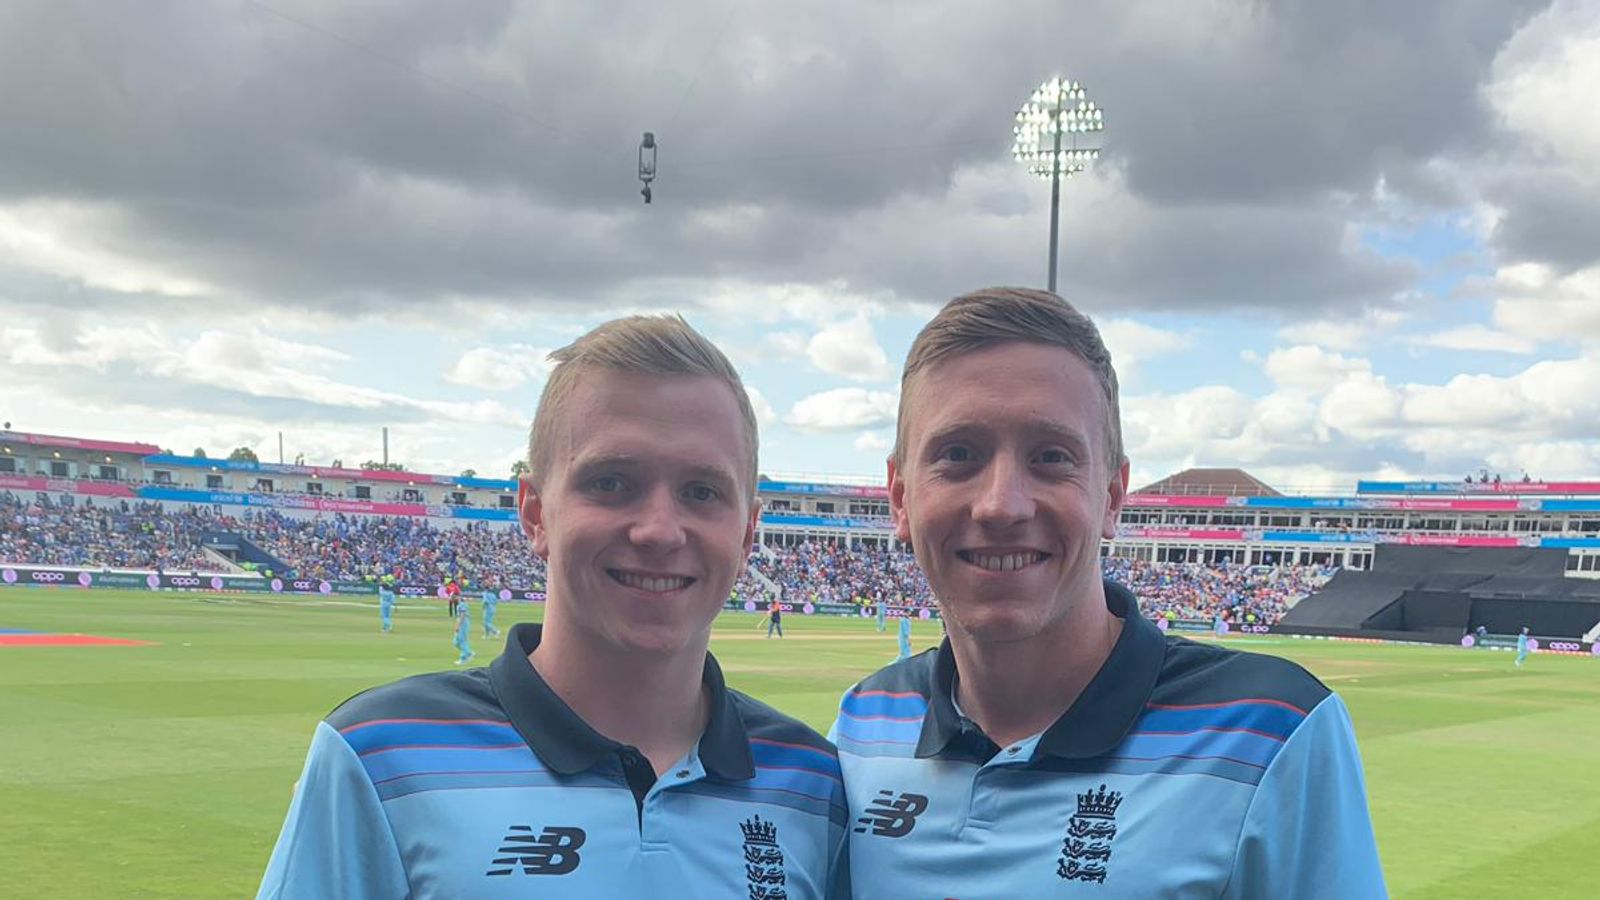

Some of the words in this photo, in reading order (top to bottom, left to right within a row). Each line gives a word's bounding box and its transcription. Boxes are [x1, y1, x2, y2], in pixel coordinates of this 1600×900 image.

[32, 572, 65, 583] oppo
[171, 577, 200, 586] oppo
[1549, 641, 1580, 651] oppo
[853, 789, 929, 838] NB
[486, 825, 587, 876] NB
